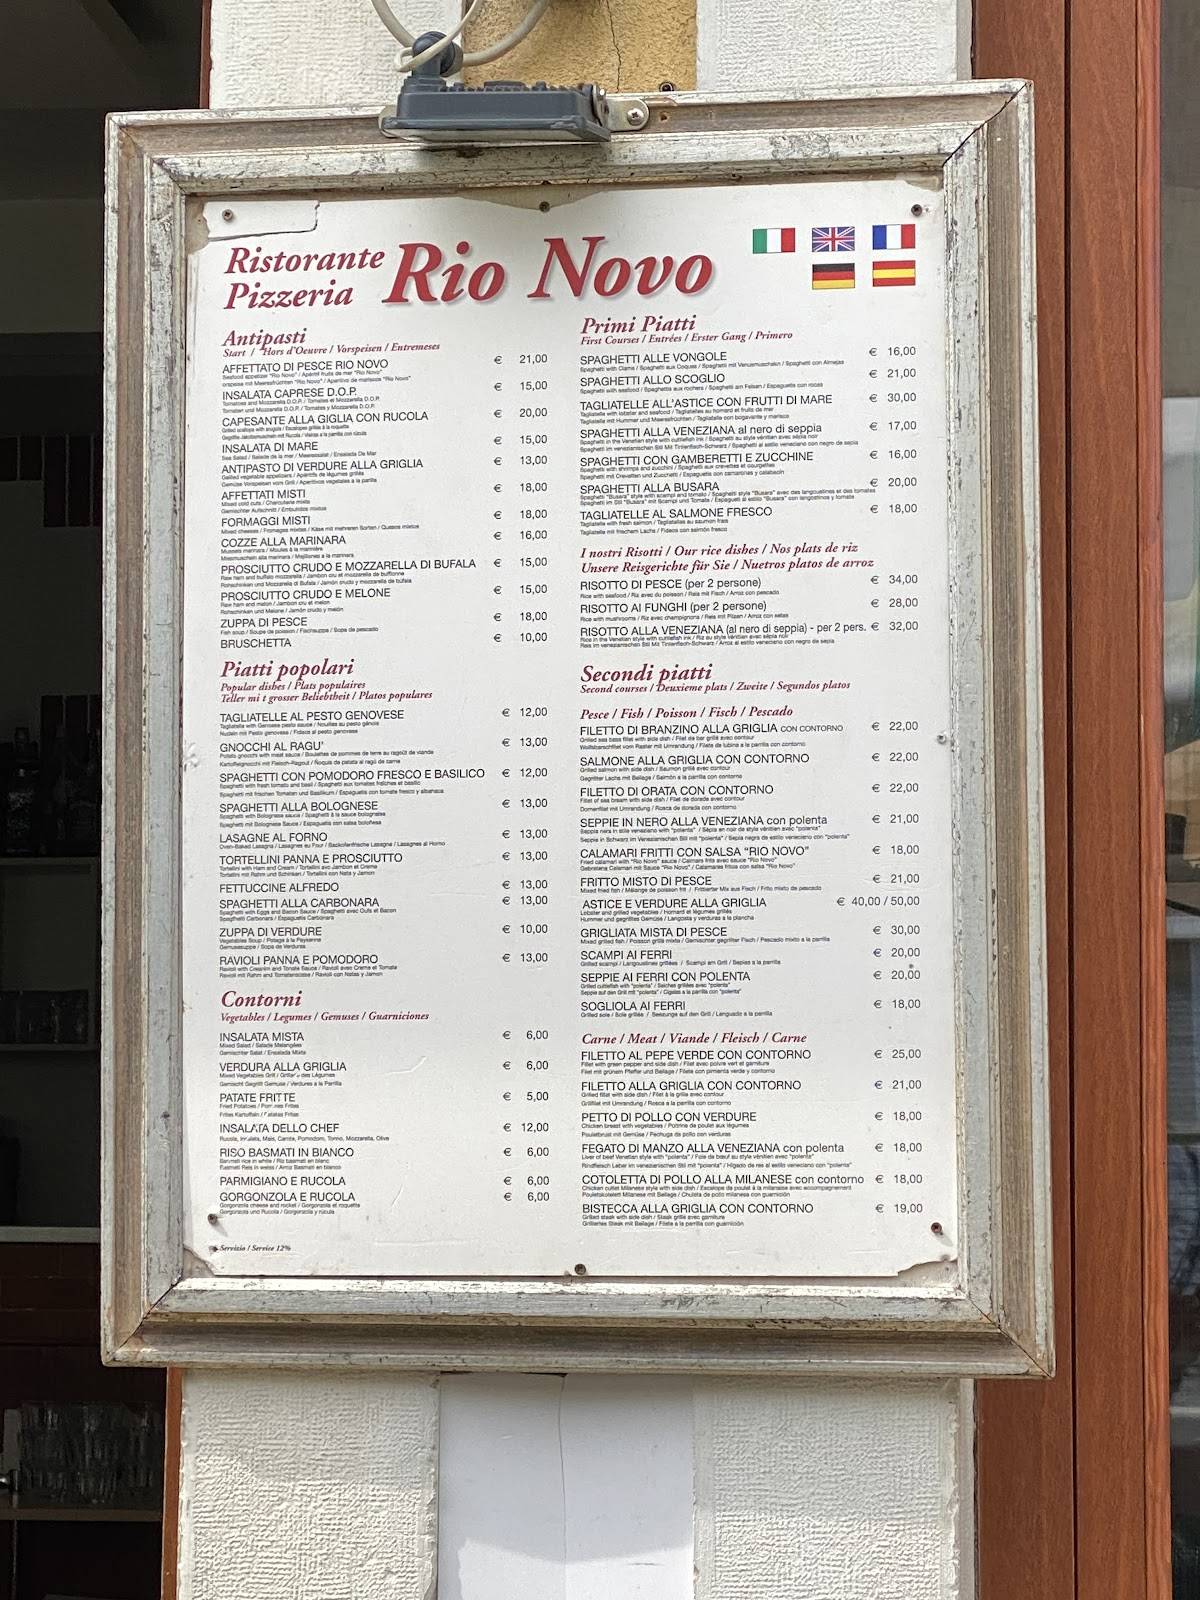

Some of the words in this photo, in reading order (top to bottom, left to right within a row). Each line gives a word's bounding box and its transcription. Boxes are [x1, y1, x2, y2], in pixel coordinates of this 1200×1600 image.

[224, 246, 385, 273] Ristorante
[382, 242, 506, 303] Rio
[527, 236, 713, 298] Novo
[223, 279, 353, 309] Pizzeria
[580, 316, 636, 334] Primi
[640, 314, 696, 333] Piatti
[222, 328, 307, 352] Antipasti
[868, 347, 877, 356] €
[888, 346, 916, 356] 16,00
[494, 355, 502, 364] €
[519, 353, 547, 364] 21,00
[580, 354, 640, 365] SPAGHETTI
[642, 353, 670, 363] ALLE
[672, 351, 726, 362] VONGOLE
[222, 362, 280, 373] AFFETTATO
[284, 362, 293, 371] DI
[297, 361, 332, 371] PESCE
[335, 360, 354, 369] RIO
[356, 359, 388, 370] NOVO
[494, 382, 502, 391] €
[520, 380, 547, 391] 15,00
[222, 389, 271, 400] INSALATA
[274, 387, 324, 398] CAPRESE
[327, 386, 356, 396] D.O.P.
[493, 436, 502, 445] €
[520, 434, 547, 445] 15,00
[222, 443, 271, 453] INSALATA
[274, 442, 284, 451] DI
[287, 441, 318, 451] MARE
[493, 531, 501, 540] €
[520, 530, 547, 540] 16,00
[221, 537, 257, 547] COZZE
[259, 537, 286, 546] ALLA
[289, 535, 346, 545] MARINARA
[581, 562, 618, 573] Unsere
[622, 560, 688, 575] Reisgerichte
[689, 559, 709, 574] für
[712, 559, 730, 570] Sie
[740, 559, 785, 569] Nuetros
[787, 559, 822, 572] platos
[826, 556, 839, 567] de
[221, 590, 290, 601] PROSCIUTTO
[293, 589, 332, 599] CRUDO
[335, 589, 341, 598] E
[345, 588, 390, 598] MELONE
[493, 585, 502, 594] €
[520, 584, 547, 594] 15,00
[580, 603, 628, 613] RISOTTO
[631, 603, 641, 614] AI
[645, 602, 687, 613] FUNGHI
[690, 602, 710, 615] (per
[713, 601, 718, 610] 2
[722, 600, 768, 615] persone)
[870, 598, 879, 607] €
[889, 597, 918, 608] 28,00
[220, 661, 273, 678] Piatti
[277, 658, 354, 682] popolari
[580, 663, 654, 682] Secondi
[656, 663, 713, 687] piatti
[219, 712, 287, 722] TAGLIATELLE
[290, 712, 303, 721] AL
[306, 711, 342, 720] PESTO
[345, 709, 404, 720] GENOVESE
[501, 708, 510, 717] €
[520, 707, 547, 717] 12,00
[580, 709, 609, 719] Pesce
[620, 707, 643, 718] Fish
[655, 707, 696, 718] Poisson
[708, 706, 737, 717] Fisch
[748, 705, 792, 716] Pescado
[220, 833, 269, 843] LASAGNE
[272, 833, 286, 842] AL
[289, 832, 328, 842] FORNO
[502, 829, 510, 838] €
[520, 828, 547, 839] 13,00
[580, 877, 619, 886] FRITTO
[622, 876, 657, 886] MISTO
[661, 876, 671, 886] DI
[675, 876, 711, 885] PESCE
[872, 874, 880, 883] €
[890, 873, 919, 884] 21,00
[580, 950, 623, 960] SCAMPI
[626, 950, 636, 959] AI
[640, 950, 672, 959] FERRI
[873, 948, 881, 957] €
[889, 947, 920, 958] 20,00
[221, 990, 302, 1007] Contorni
[221, 1012, 265, 1024] Vegetables
[273, 1012, 312, 1024] Legumes
[321, 1011, 359, 1020] Gemuses
[368, 1011, 429, 1020] Guarniciones
[220, 1032, 269, 1041] INSALATA
[272, 1032, 304, 1041] MISTA
[502, 1030, 510, 1039] €
[526, 1030, 548, 1040] 6,00
[582, 1033, 616, 1044] Carne
[627, 1033, 657, 1043] Meat
[670, 1032, 709, 1043] Viande
[721, 1032, 759, 1043] Fleisch
[771, 1032, 807, 1042] Carne
[220, 1093, 256, 1102] PATATE
[259, 1092, 295, 1102] FRITTE
[502, 1092, 511, 1100] €
[526, 1091, 548, 1102] 5,00
[582, 1112, 617, 1122] PETTO
[620, 1112, 631, 1122] DI
[635, 1112, 672, 1122] POLLO
[675, 1112, 700, 1121] CON
[703, 1112, 756, 1121] VERDURE
[874, 1111, 883, 1120] €
[893, 1111, 921, 1122] 18,00
[219, 1192, 297, 1201] GORGONZOLA
[300, 1192, 306, 1202] E
[310, 1192, 355, 1201] RUCOLA
[503, 1192, 512, 1201] €
[527, 1191, 549, 1202] 6,00
